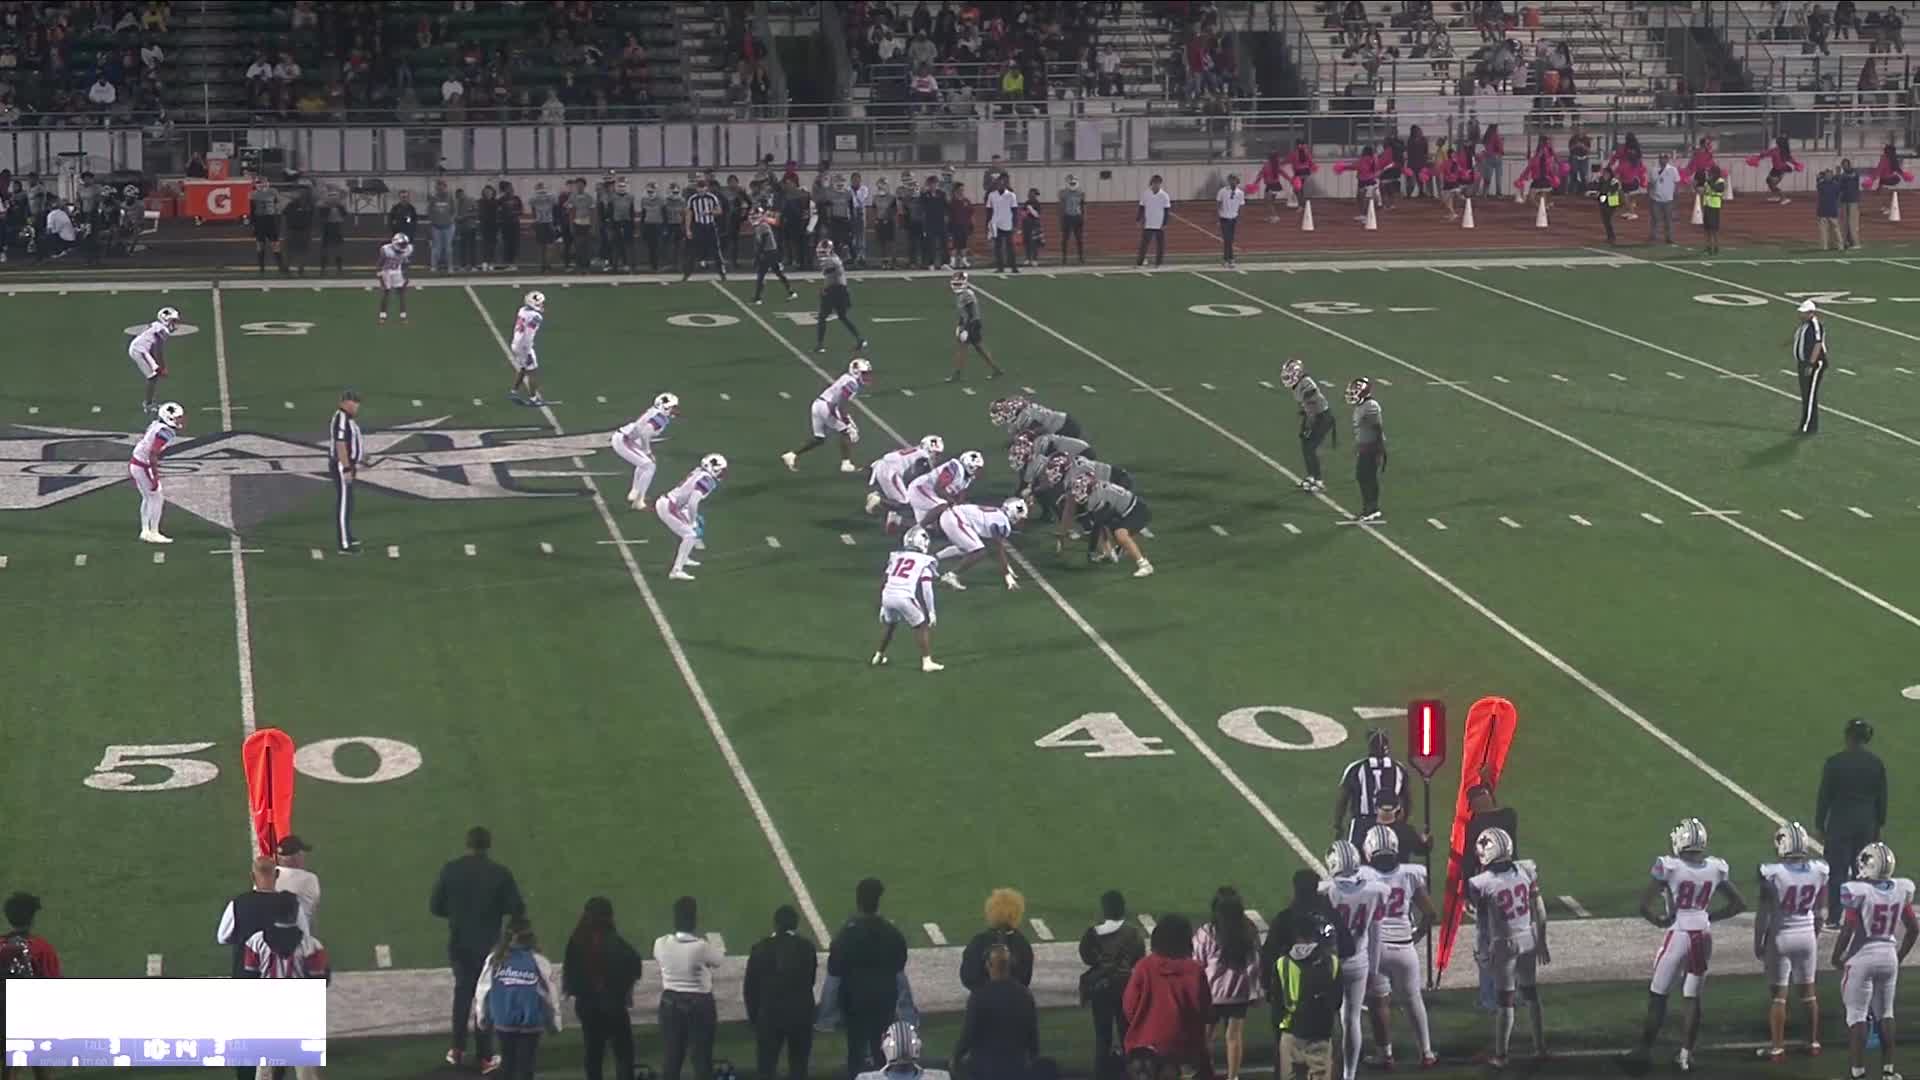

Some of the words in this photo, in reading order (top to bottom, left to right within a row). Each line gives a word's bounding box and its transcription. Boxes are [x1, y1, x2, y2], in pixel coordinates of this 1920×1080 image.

[207, 187, 232, 215] G
[893, 557, 916, 579] 12
[1035, 706, 1349, 758] 40
[83, 736, 422, 792] 50
[1495, 883, 1528, 921] 23
[1676, 880, 1713, 910] 84
[1783, 884, 1817, 914] 42
[1871, 903, 1901, 936] 51
